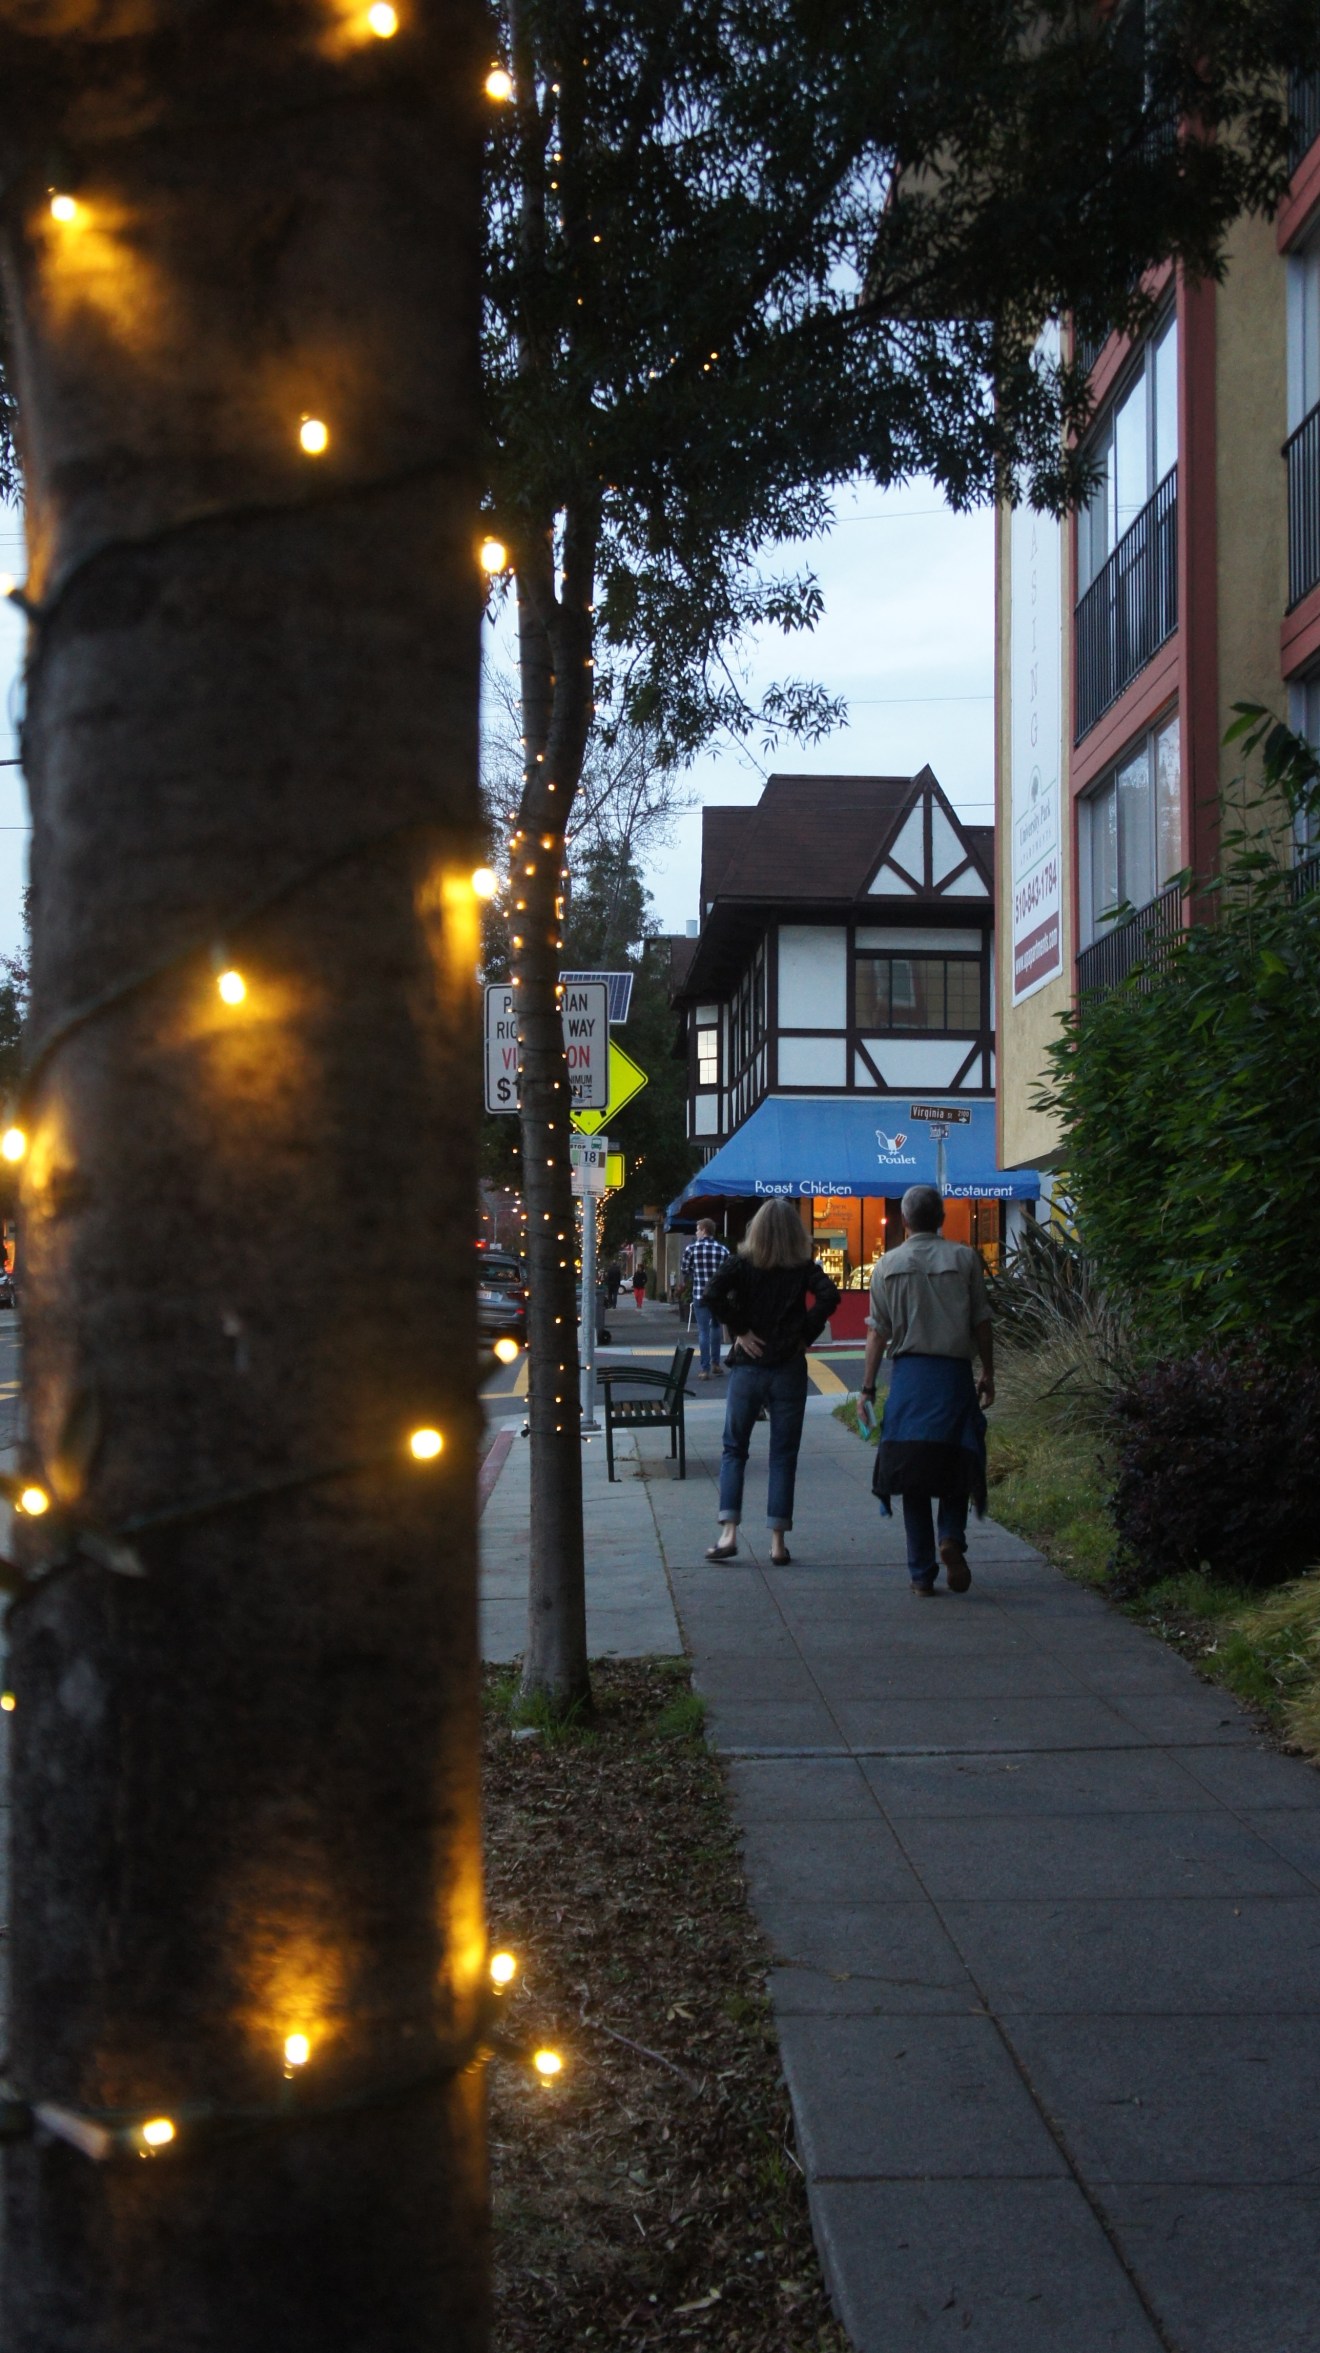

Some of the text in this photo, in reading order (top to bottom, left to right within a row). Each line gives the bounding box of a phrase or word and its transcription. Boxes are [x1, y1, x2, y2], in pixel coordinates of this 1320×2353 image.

[1015, 858, 1057, 925] 510-843-1784
[568, 1018, 595, 1037] WAY
[912, 1106, 944, 1120] Virginia
[584, 1151, 597, 1163] 18
[877, 1154, 917, 1165] Poulet
[755, 1180, 1013, 1197] Roast Chicken Restaurant
